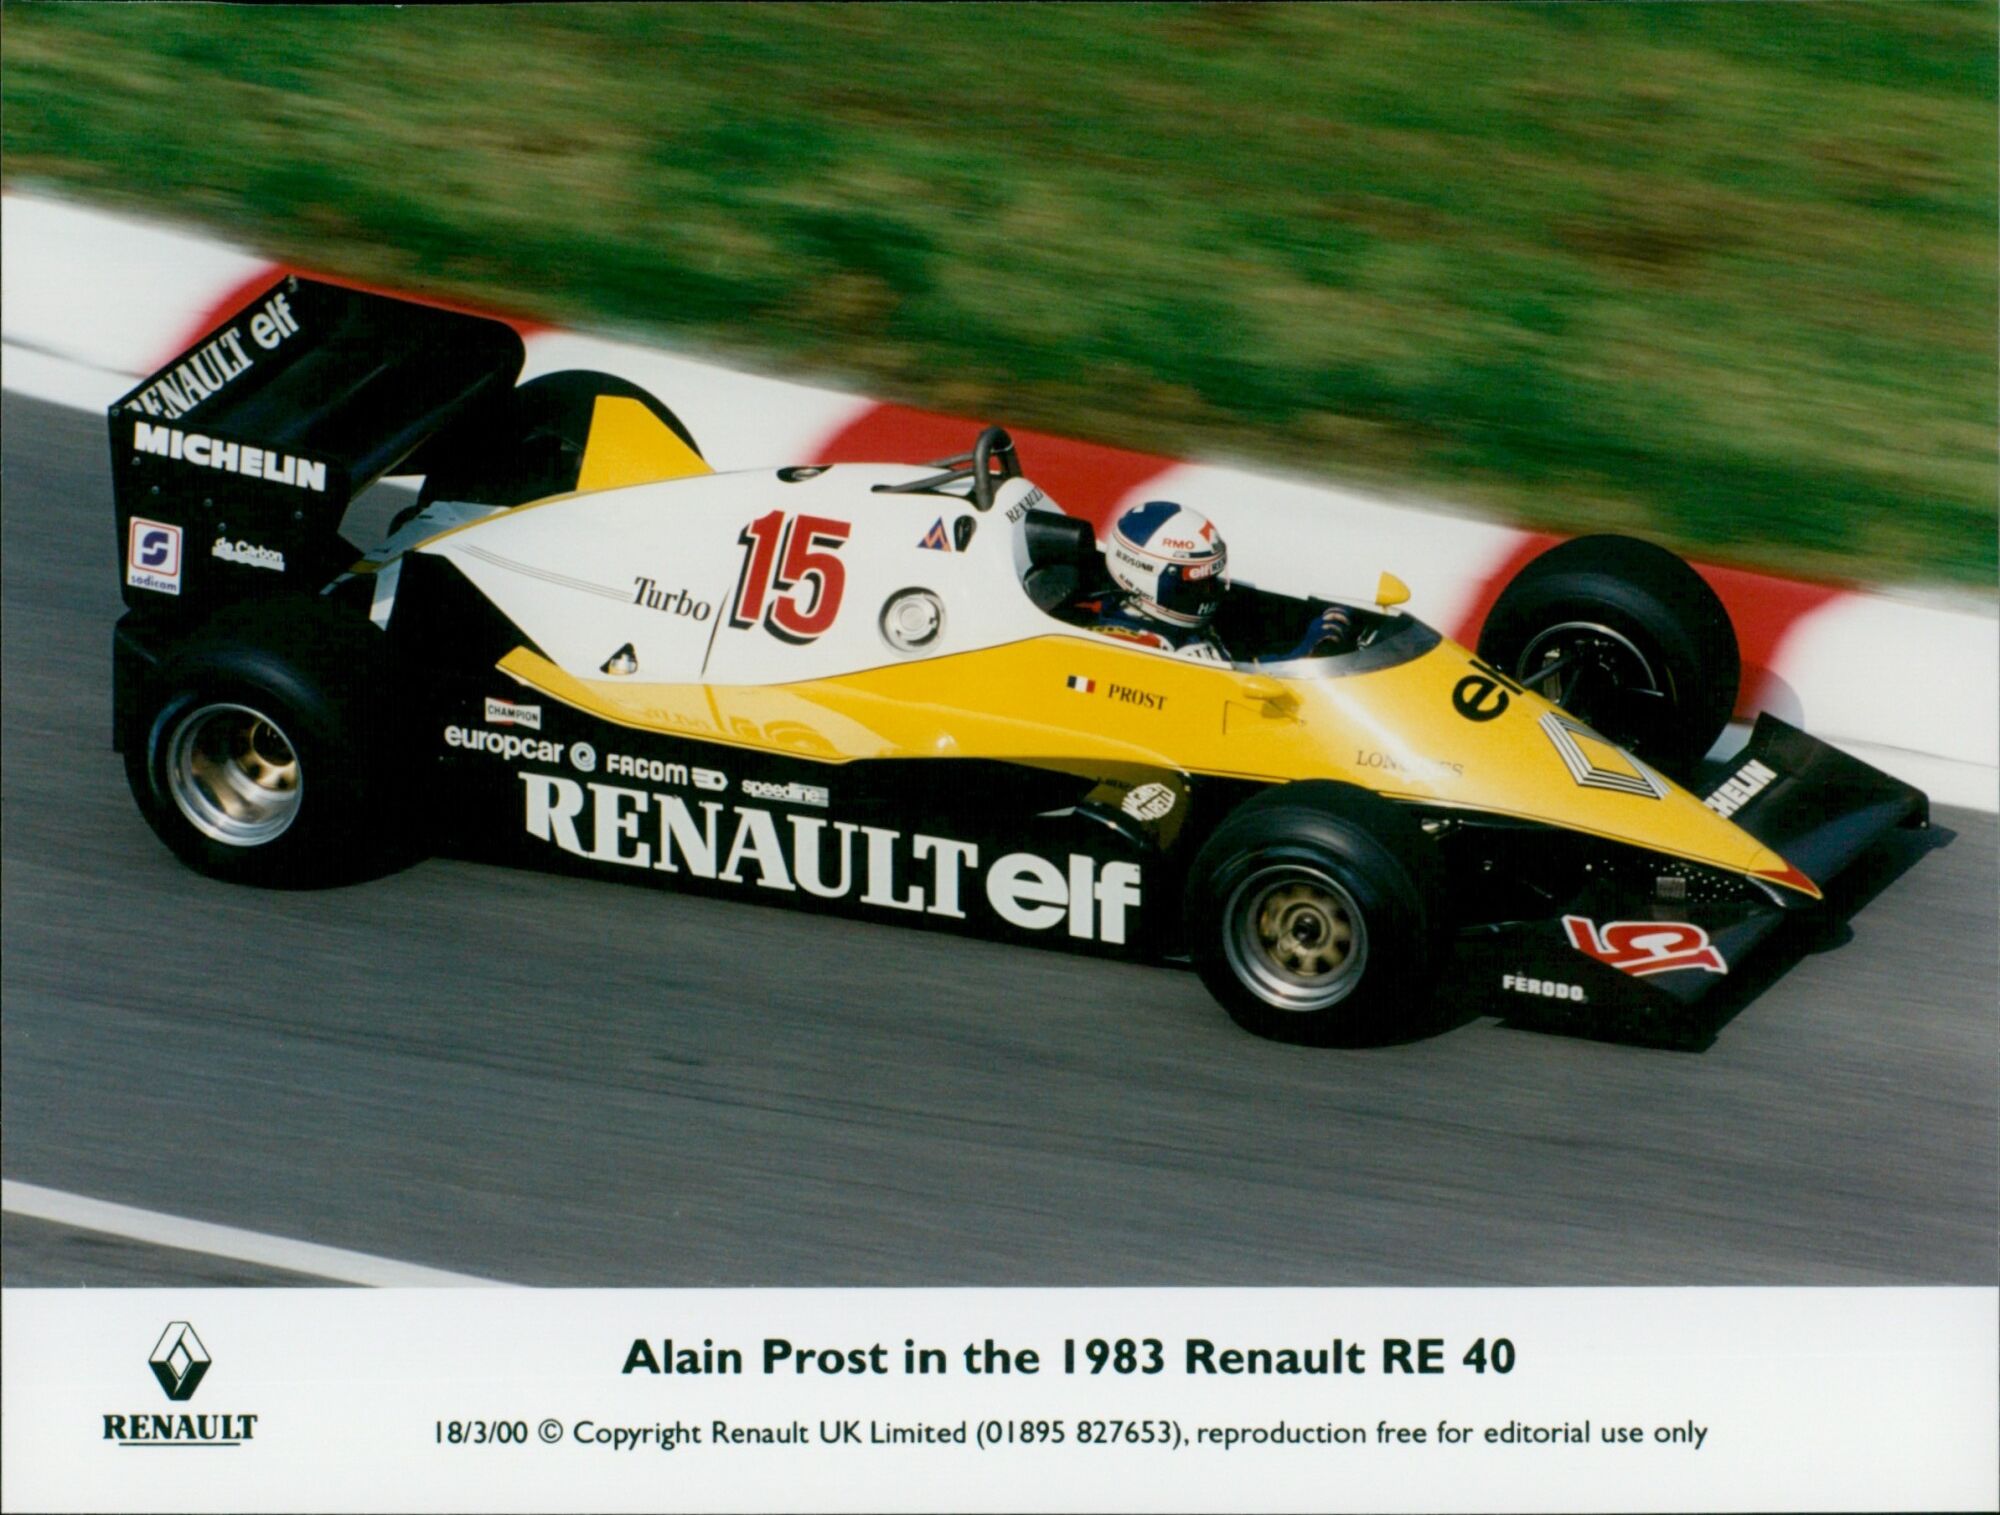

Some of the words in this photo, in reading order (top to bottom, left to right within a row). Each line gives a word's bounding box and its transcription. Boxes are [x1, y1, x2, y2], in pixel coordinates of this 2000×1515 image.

[250, 292, 300, 350] elf
[134, 421, 326, 492] MICHELIN
[1162, 537, 1195, 550] RMO
[728, 508, 852, 646] 15
[633, 576, 711, 622] Turbo
[1108, 683, 1168, 712] PROST
[1452, 659, 1525, 722] el
[487, 703, 540, 723] CHAMPION
[444, 724, 564, 763] europcar
[606, 753, 688, 785] FACOM
[1702, 758, 1778, 819] HELIN
[741, 778, 824, 805] speedline
[518, 771, 979, 919] RENAULT
[986, 851, 1142, 944] elf
[1502, 975, 1584, 1001] FERODO
